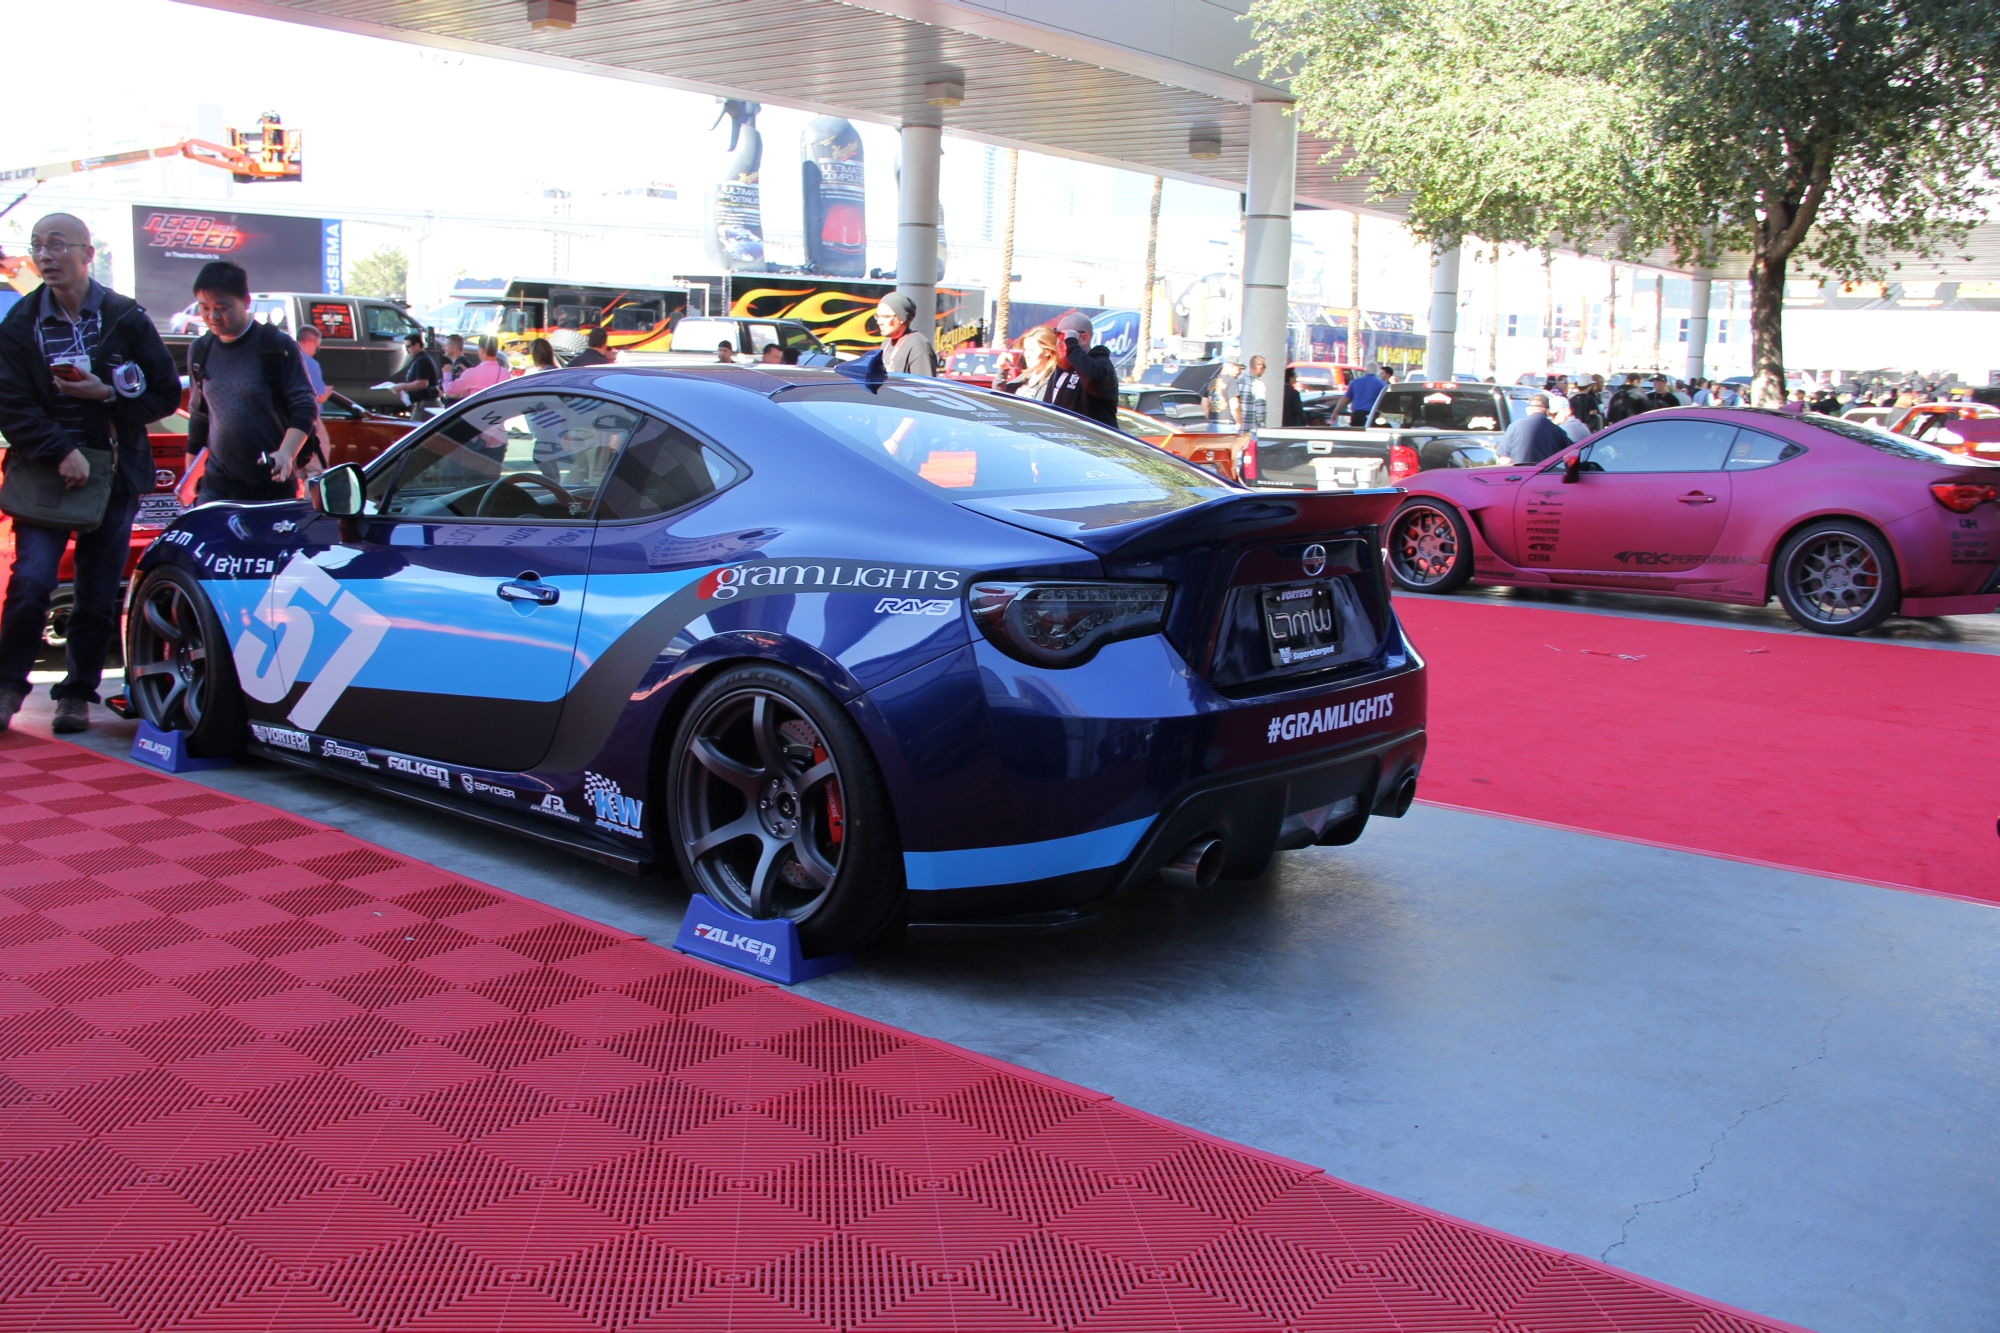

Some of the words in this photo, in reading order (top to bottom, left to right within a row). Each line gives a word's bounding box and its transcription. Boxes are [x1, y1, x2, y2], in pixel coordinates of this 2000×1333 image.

[143, 213, 216, 232] NEED
[149, 231, 239, 250] SPEED
[1669, 555, 1759, 566] PERFORMANCE
[712, 565, 825, 600] gram
[829, 566, 960, 591] LIGHTS
[1281, 588, 1314, 600] VORTECH
[874, 597, 954, 616] RAYS
[233, 550, 391, 731] 57
[1293, 645, 1335, 660] Supercharged
[1267, 692, 1394, 744] #GRAMLIGHTS
[265, 727, 310, 748] VORTECH
[138, 738, 171, 758] FALKEN
[322, 739, 369, 763] ROTORA
[387, 756, 450, 782] FALKEN
[474, 782, 516, 799] SPYDER
[594, 788, 644, 829] KW
[694, 923, 777, 959] FALKEN
[755, 954, 773, 966] TIRE
